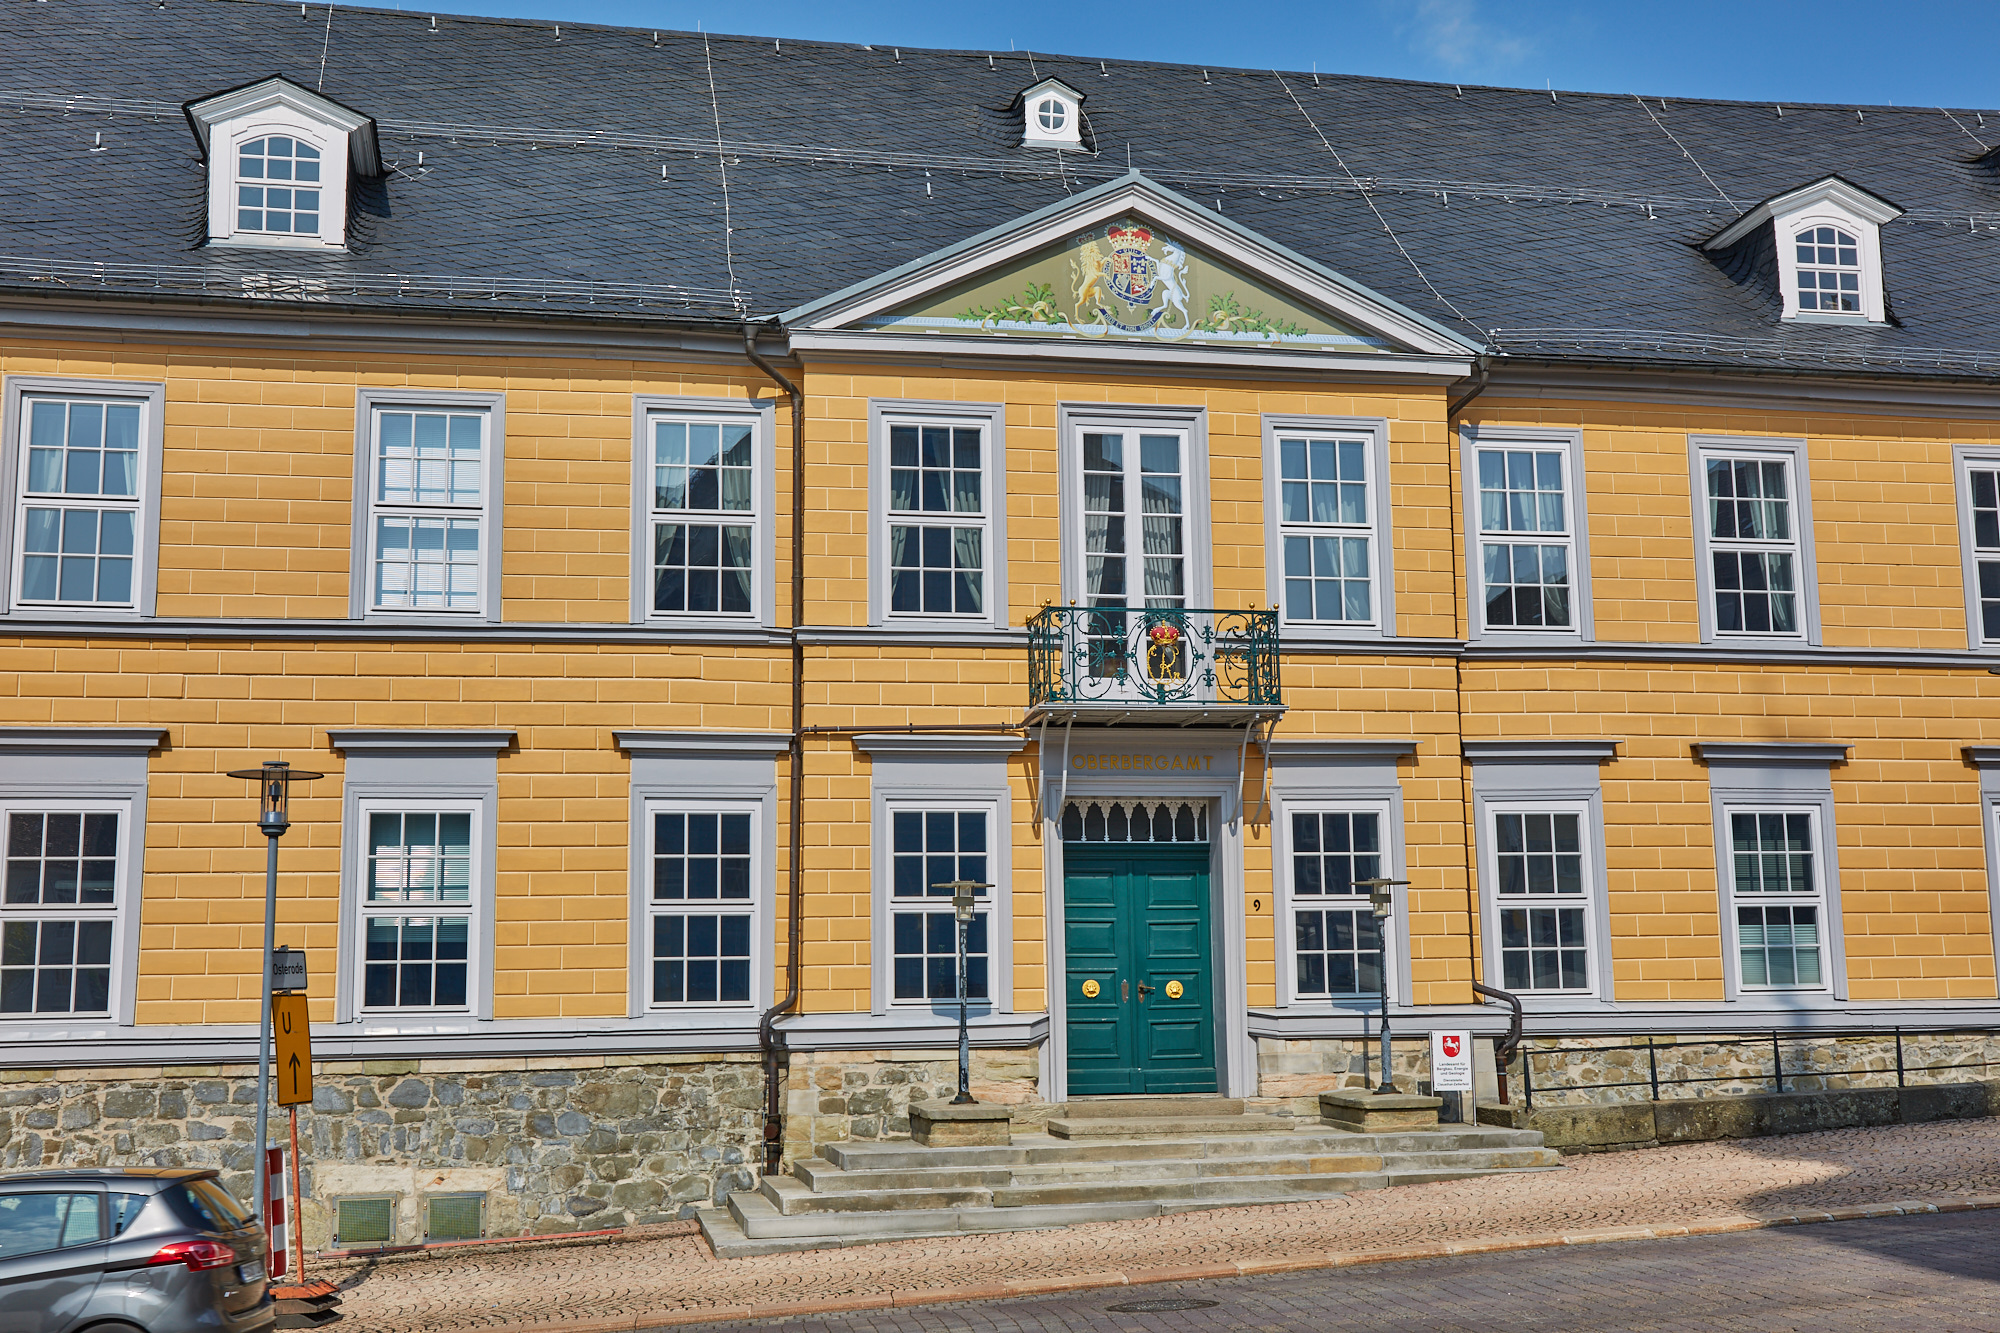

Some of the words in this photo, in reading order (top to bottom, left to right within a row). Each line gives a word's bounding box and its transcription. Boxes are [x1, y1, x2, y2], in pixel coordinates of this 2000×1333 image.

[1072, 754, 1214, 770] OBERBERGAMT
[1254, 899, 1260, 912] 9
[273, 962, 304, 976] Osterode
[281, 1011, 291, 1035] U
